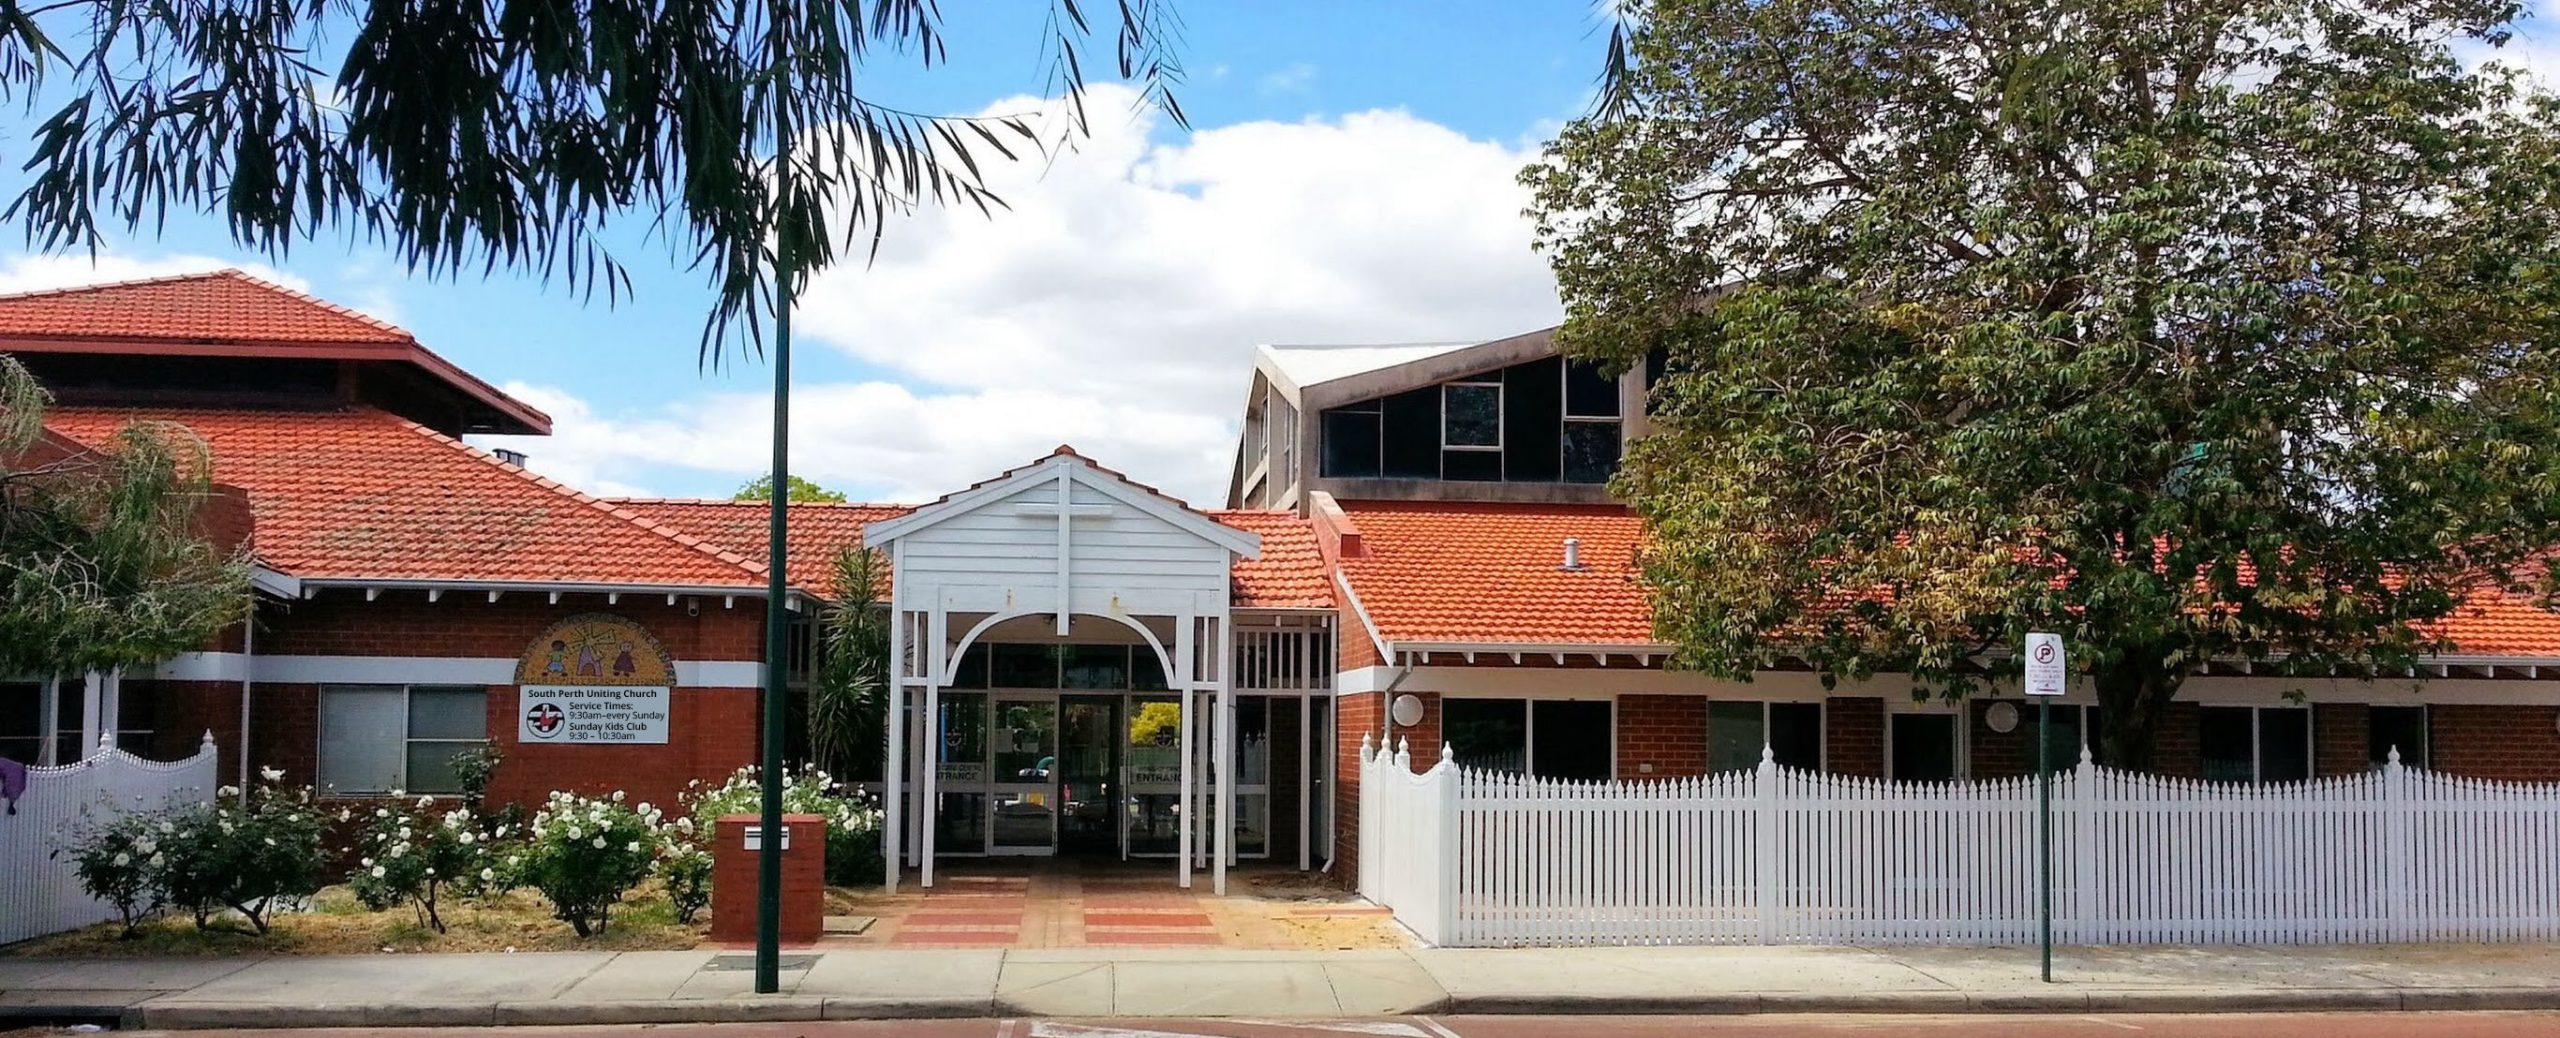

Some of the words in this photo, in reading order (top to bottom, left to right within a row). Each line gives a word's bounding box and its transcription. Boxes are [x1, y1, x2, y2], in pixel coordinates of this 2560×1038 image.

[528, 689, 555, 698] South
[558, 689, 584, 698] Perth
[587, 689, 621, 699] Uniting
[624, 689, 657, 698] Church
[569, 701, 601, 710] Service
[604, 701, 633, 710] Times:
[632, 711, 665, 721] Sunday
[569, 722, 602, 732] Sunday
[605, 722, 624, 731] Kids
[627, 722, 647, 731] Club
[569, 732, 588, 740] 9:30
[598, 732, 635, 740] 10:30am
[936, 772, 977, 781] TRANCE
[1136, 773, 1181, 782] ENTRAN
